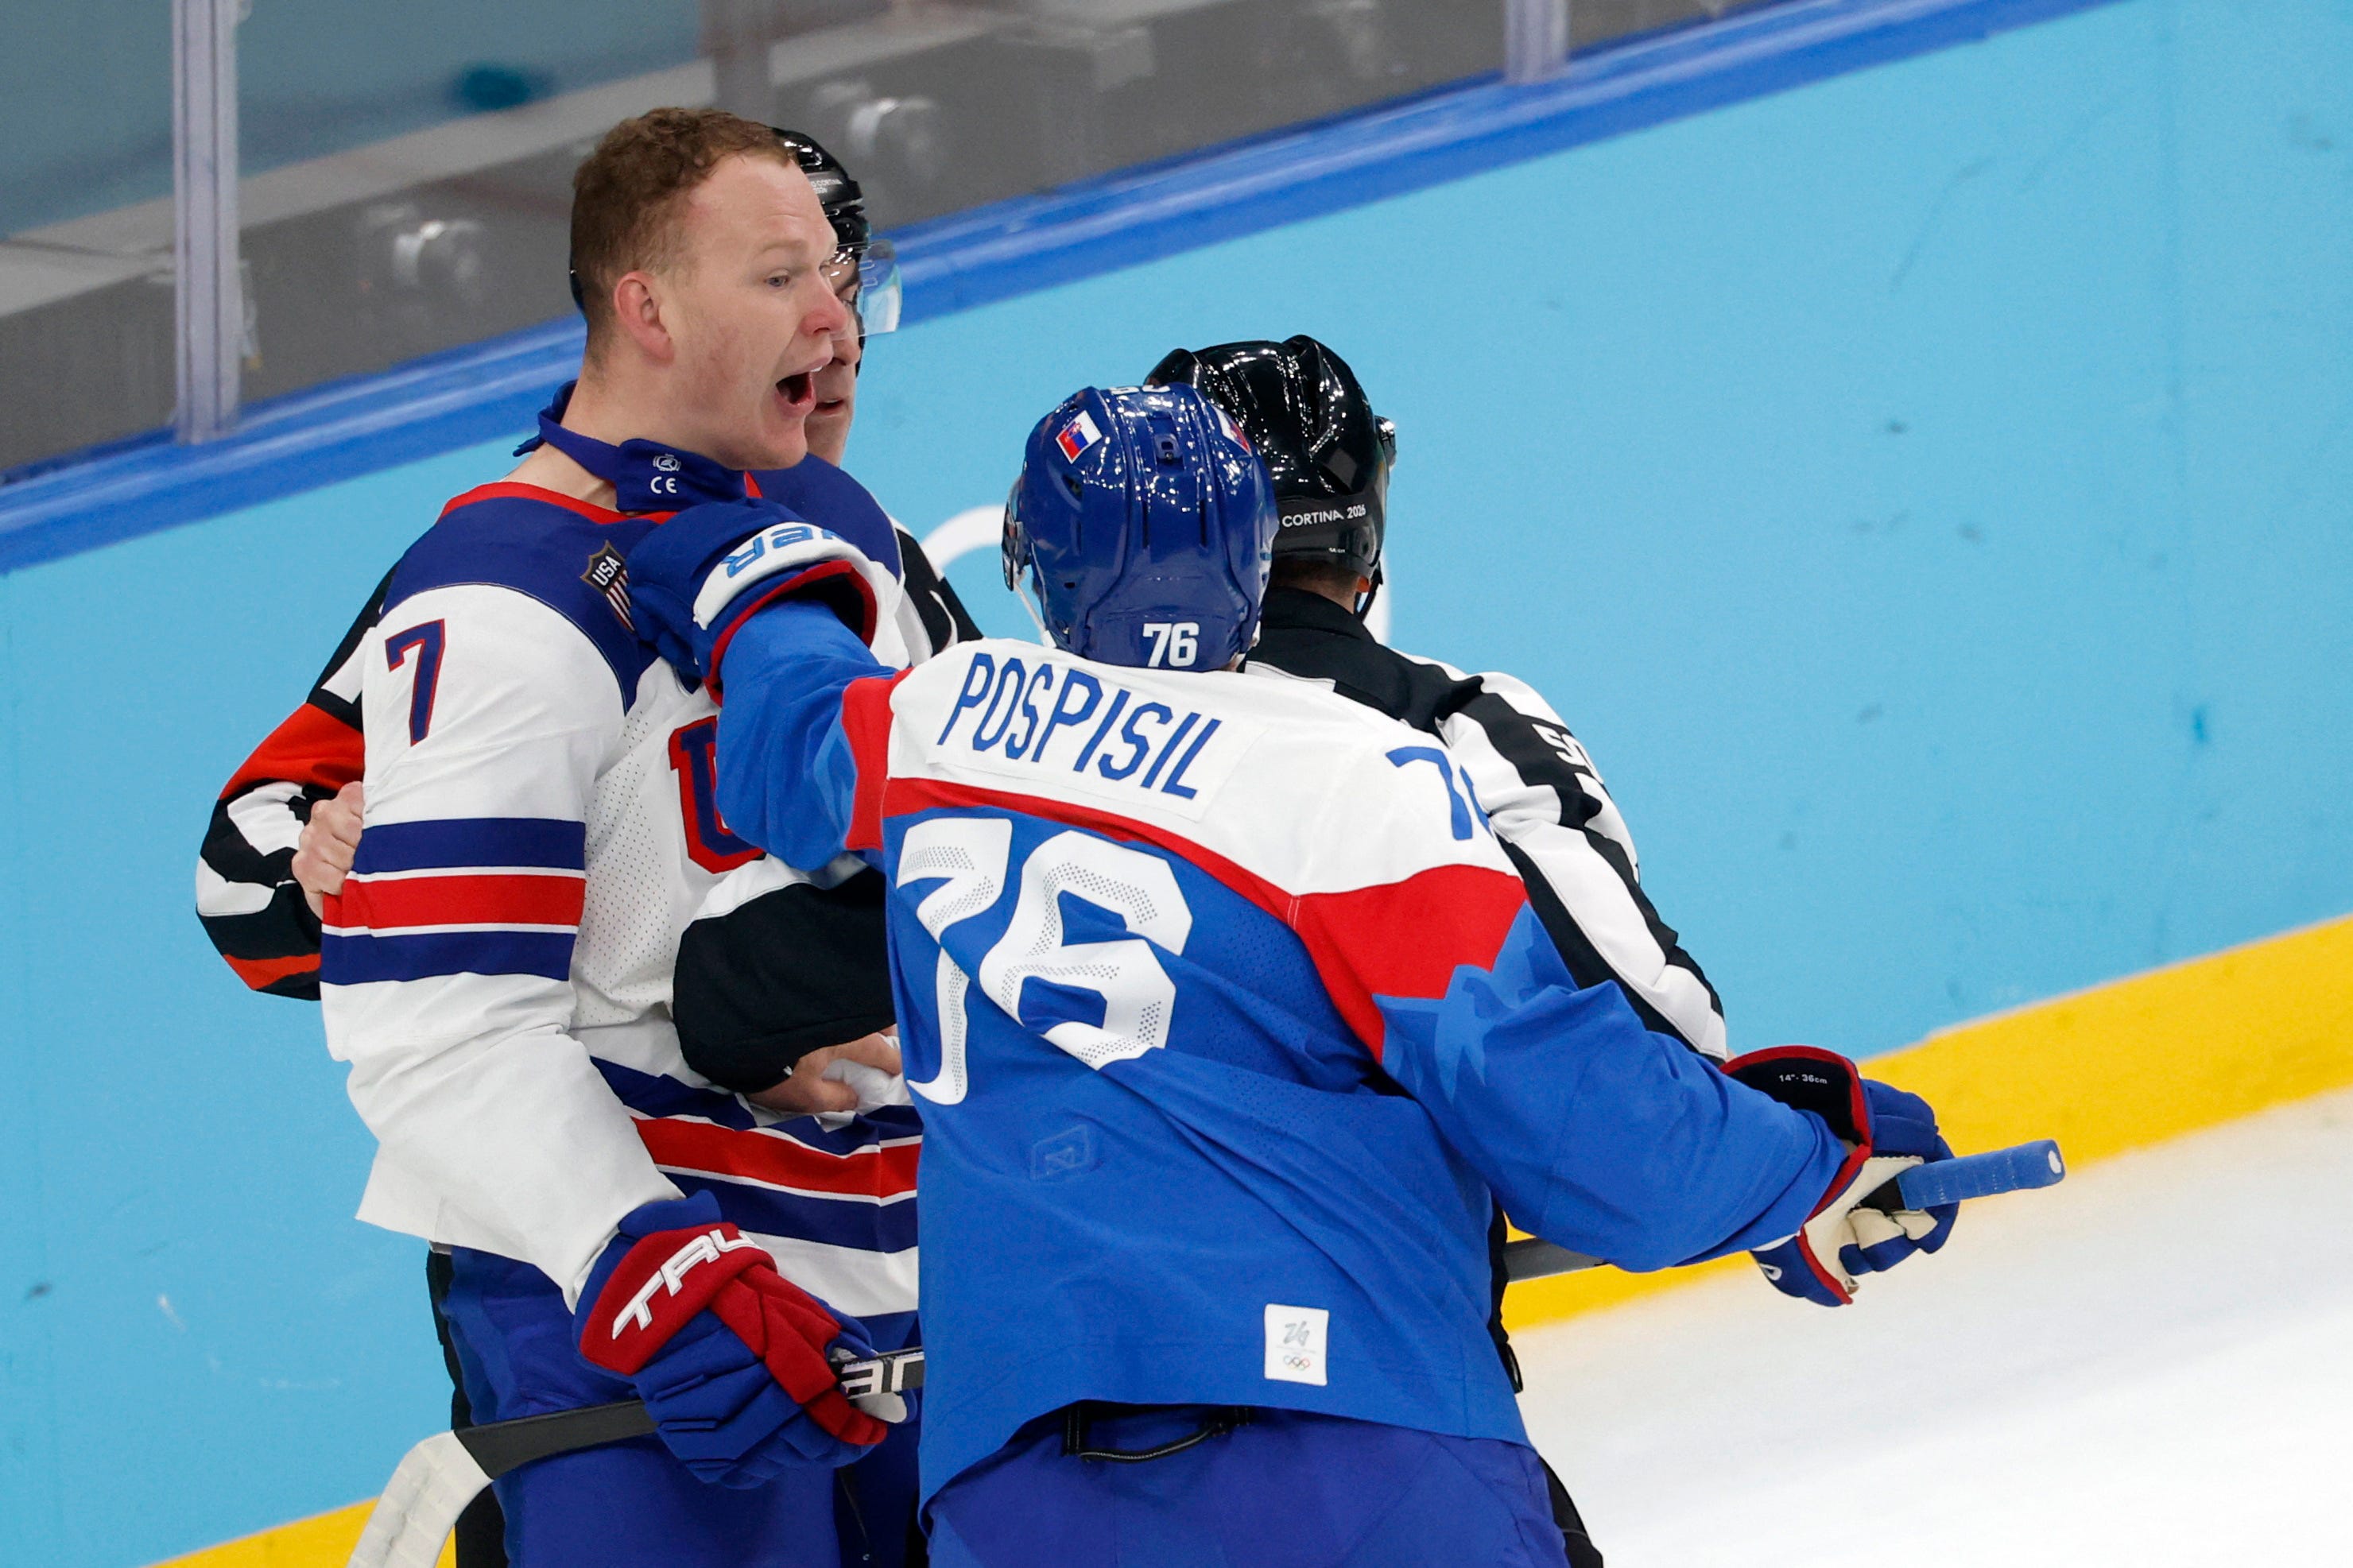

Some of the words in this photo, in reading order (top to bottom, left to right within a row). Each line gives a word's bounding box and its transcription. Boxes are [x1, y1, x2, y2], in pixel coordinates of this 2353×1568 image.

[649, 475, 677, 494] CE
[1281, 509, 1344, 528] CORTINA
[1346, 504, 1366, 519] 2026
[591, 556, 621, 586] USA
[1142, 621, 1200, 668] 76
[385, 618, 446, 747] 7
[937, 652, 1223, 800] POSPISIL
[896, 817, 1192, 1105] 76
